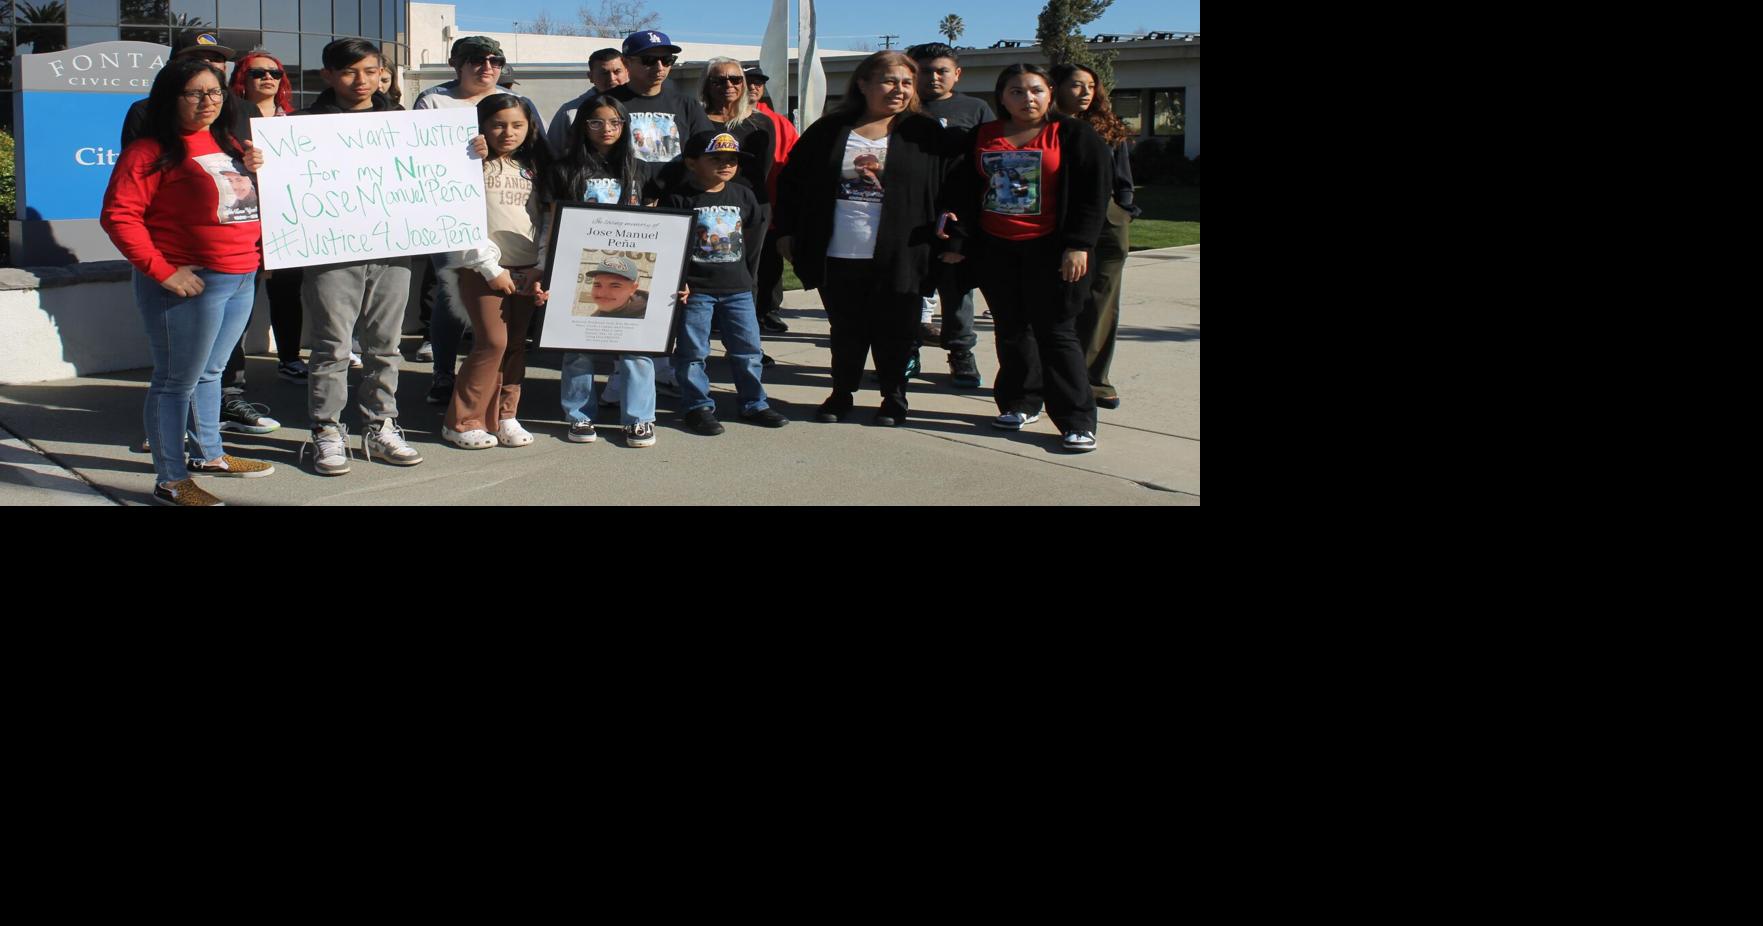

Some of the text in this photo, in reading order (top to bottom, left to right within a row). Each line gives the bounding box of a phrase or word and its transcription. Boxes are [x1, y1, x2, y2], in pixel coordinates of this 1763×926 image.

[48, 53, 164, 77] FONTA
[68, 77, 120, 86] CIVIC
[629, 112, 675, 121] FROSTY
[258, 125, 316, 157] We
[337, 120, 400, 149] want
[75, 147, 119, 166] Cit
[300, 160, 340, 187] for
[358, 166, 382, 186] my
[504, 176, 532, 190] ANGE
[586, 227, 659, 240] Jose Manuel
